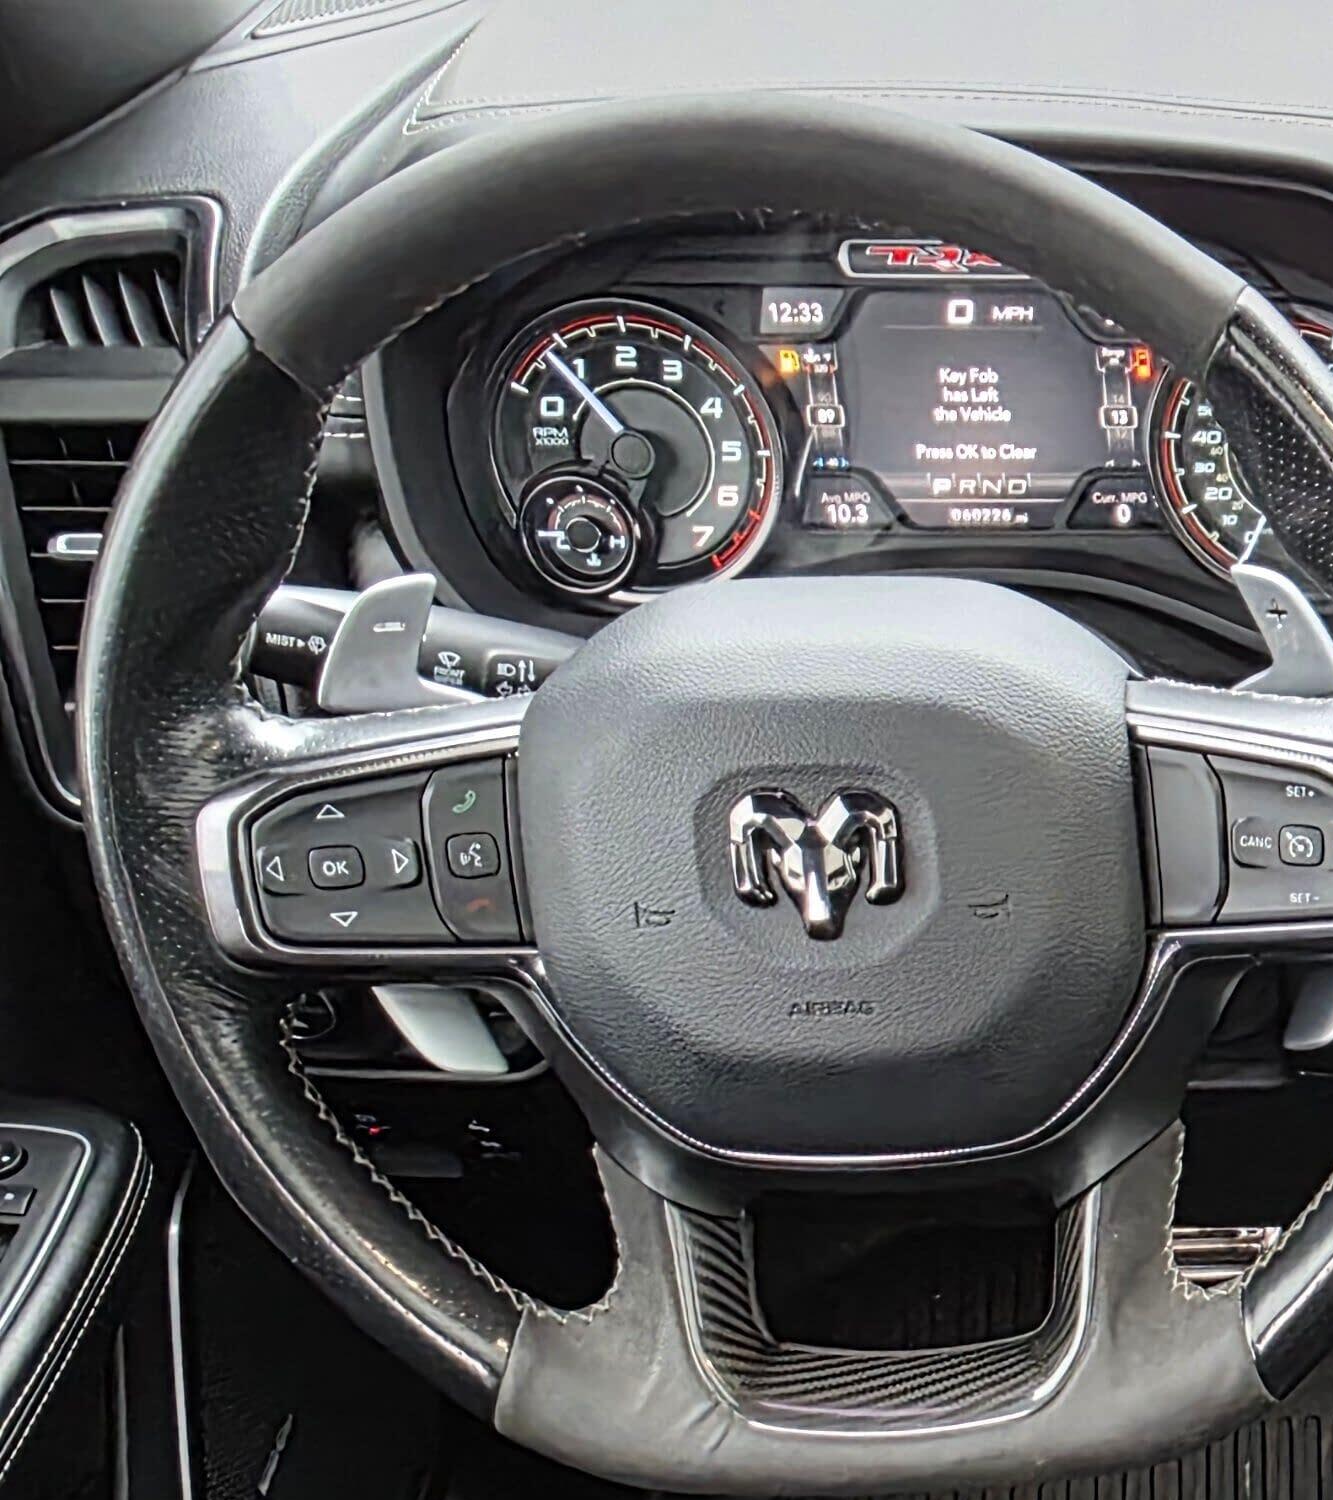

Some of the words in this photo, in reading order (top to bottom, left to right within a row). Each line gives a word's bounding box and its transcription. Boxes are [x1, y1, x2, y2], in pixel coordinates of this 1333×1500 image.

[768, 302, 824, 323] 12:33
[947, 299, 974, 325] 0
[992, 306, 1034, 321] MPH
[615, 346, 638, 367] 2
[572, 359, 585, 379] 1
[662, 360, 683, 381] 3
[939, 368, 967, 386] Key
[969, 368, 999, 384] Fob
[943, 387, 968, 403] has
[970, 387, 999, 403] Left
[540, 396, 564, 417] 0
[701, 397, 723, 418] 4
[933, 406, 958, 422] the
[959, 406, 1012, 422] Vehicle
[533, 427, 568, 438] RPM
[1192, 430, 1222, 444] 40
[722, 441, 742, 462] 5
[915, 444, 953, 460] Press
[955, 444, 979, 460] OK
[981, 446, 997, 460] to
[999, 444, 1037, 460] Clear
[932, 478, 952, 495] P
[1204, 486, 1233, 500] 20
[718, 485, 739, 506] 6
[843, 491, 871, 503] MPG
[1121, 492, 1148, 504] MPG
[827, 503, 869, 523] 10.3
[1116, 504, 1131, 524] 0
[1222, 515, 1238, 526] 10
[610, 535, 625, 549] H
[692, 526, 715, 547] 7
[266, 632, 296, 648] MIST
[1240, 835, 1272, 849] CANC
[323, 860, 348, 877] OK
